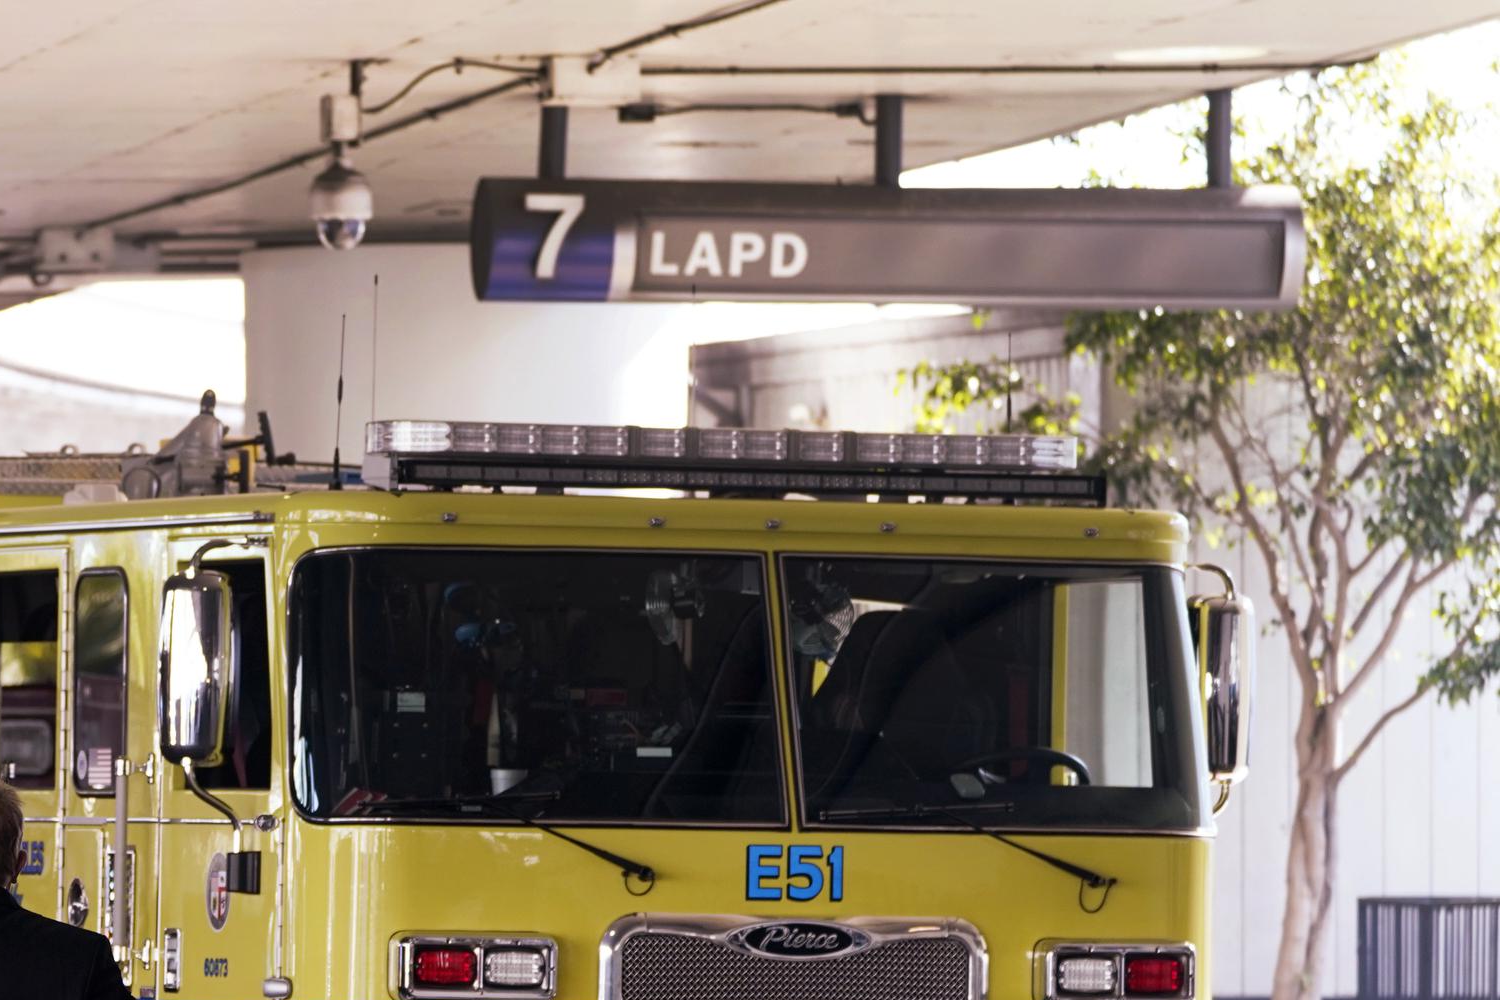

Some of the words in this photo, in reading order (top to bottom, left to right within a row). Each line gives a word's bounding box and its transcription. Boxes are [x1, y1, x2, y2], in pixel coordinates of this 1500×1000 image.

[524, 193, 585, 280] 7
[649, 231, 809, 278] LAPD
[745, 844, 845, 902] E51
[759, 926, 840, 952] Pierce
